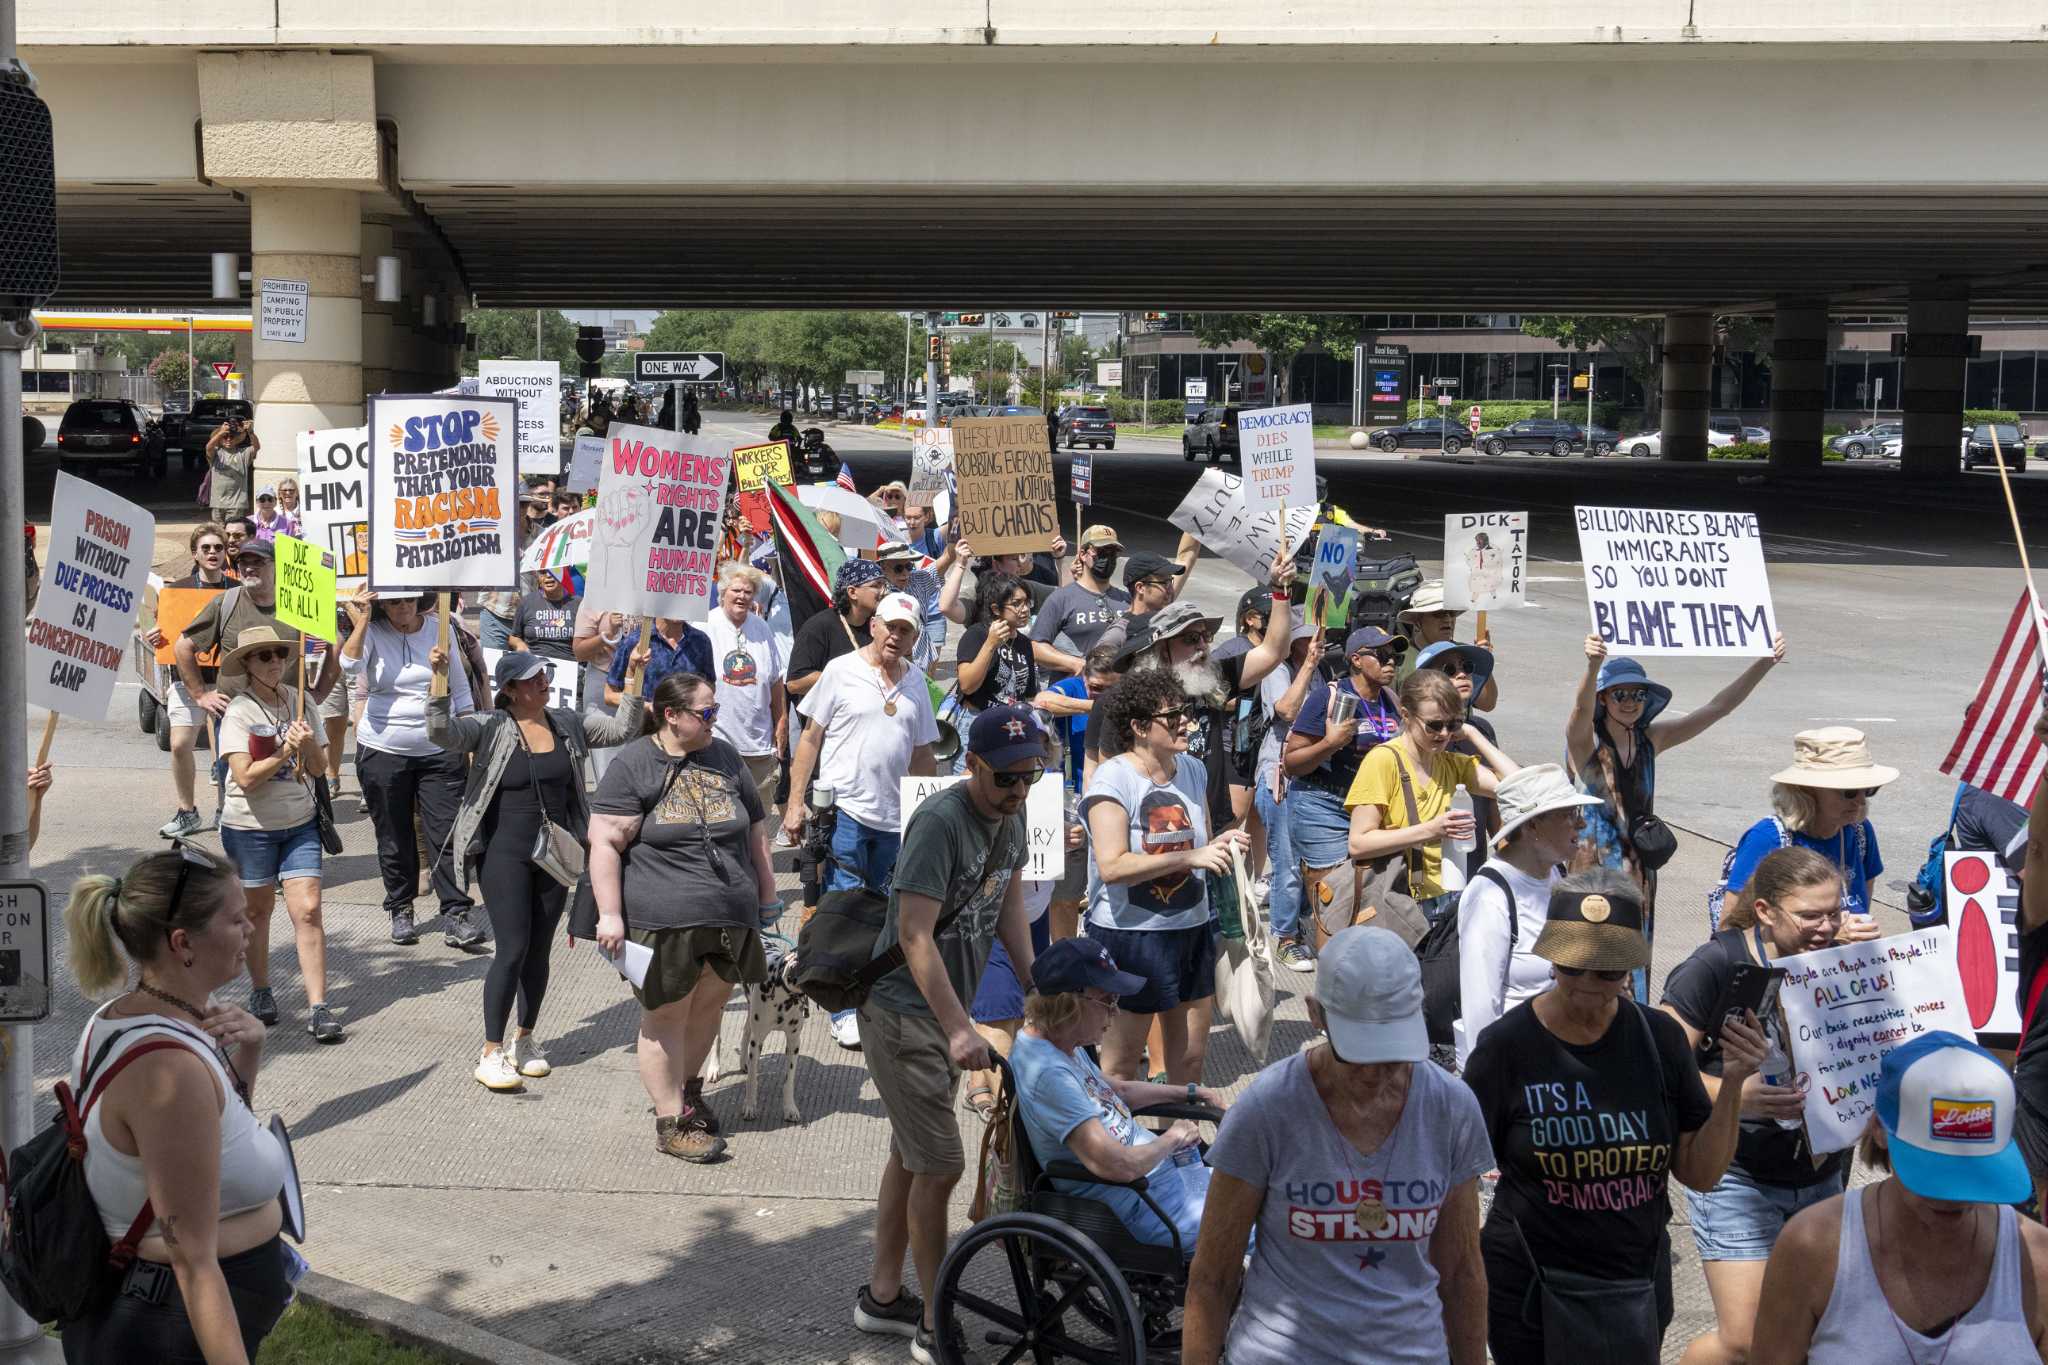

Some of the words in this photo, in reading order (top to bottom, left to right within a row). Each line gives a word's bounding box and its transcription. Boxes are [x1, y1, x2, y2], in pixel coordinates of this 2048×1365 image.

[263, 281, 306, 292] PROHIBITED
[262, 306, 271, 315] ON
[275, 307, 304, 317] PUBLIC
[266, 296, 300, 306] CAMPING
[264, 316, 302, 327] PROPERTY
[485, 376, 553, 386] ABDUCTIONS
[644, 362, 668, 374] ONE
[672, 362, 697, 374] WAY
[495, 388, 543, 398] WITHOUT
[404, 410, 480, 452] STOP
[518, 420, 545, 430] CESS
[1238, 411, 1312, 431] DEMOCRACY
[517, 432, 529, 441] RE
[517, 445, 554, 454] ERICAN
[953, 426, 991, 449] THESE
[991, 423, 1049, 445] VULTURES
[1256, 431, 1288, 448] DIES
[309, 442, 369, 473] LOC
[393, 443, 497, 475] PRETENDING
[612, 438, 725, 487] WOMENS
[736, 446, 782, 466] WORKERS
[956, 451, 1003, 478] ROBBING
[1004, 450, 1052, 474] EVERYONE
[1251, 448, 1293, 465] WHILE
[394, 472, 443, 498] THAT
[446, 465, 496, 491] YOUR
[1251, 466, 1295, 482] TRUMP
[305, 480, 363, 511] HIM
[656, 482, 720, 512] RIGHTS
[961, 480, 1013, 505] LEAVING
[1015, 475, 1056, 502] NOTHING
[1260, 483, 1291, 499] LIES
[394, 487, 502, 530] RACISM
[1192, 473, 1243, 537] DUTY
[84, 509, 131, 550] PRISON
[442, 524, 456, 540] IS
[651, 507, 718, 550] ARE
[962, 508, 988, 536] BUT
[991, 503, 1054, 538] CHAINS
[1577, 508, 1700, 536] BILLIONAIRES
[1704, 513, 1760, 538] BLAME
[74, 536, 130, 580] WITHOUT
[293, 542, 309, 566] DUE
[395, 533, 501, 568] PATRIOTISM
[648, 547, 712, 574] HUMAN
[1321, 541, 1345, 565] NO
[1510, 529, 1525, 593] TATOR
[1607, 539, 1730, 563] IMMIGRANTS
[54, 561, 81, 593] DUE
[78, 573, 133, 613] PROCESS
[283, 563, 314, 593] PROCESS
[646, 570, 708, 597] RIGHTS
[1591, 565, 1618, 589] SO
[1631, 565, 1669, 588] YOU
[1675, 567, 1728, 588] DONT
[279, 586, 293, 614] FOR
[72, 602, 85, 628] IS
[85, 608, 97, 632] A
[535, 609, 571, 621] CHINGA
[1593, 600, 1683, 648] BLAME
[1682, 602, 1774, 649] THEM
[28, 618, 123, 672] CONCENTRATION
[544, 626, 574, 638] MAGA
[50, 660, 87, 692] CAMP
[1784, 966, 1819, 989] People
[1821, 966, 1839, 978] are
[1839, 958, 1867, 977] People
[1870, 956, 1888, 966] are
[1814, 984, 1848, 1009] ALL
[1850, 977, 1871, 997] OF
[1800, 1025, 1824, 1042] Our
[1825, 1019, 1849, 1034] basic
[1914, 1001, 1945, 1015] voices
[1836, 1031, 1872, 1051] dignity
[1911, 1021, 1926, 1034] be
[1818, 1061, 1835, 1075] for
[1836, 1057, 1854, 1071] sale
[1857, 1054, 1868, 1063] or
[1869, 1052, 1879, 1061] a
[1524, 1082, 1569, 1115] IT'S
[1575, 1081, 1592, 1111] A
[1530, 1115, 1596, 1148] GOOD
[1598, 1109, 1650, 1143] DAY
[1836, 1109, 1856, 1123] but
[1534, 1151, 1568, 1179] TO
[1285, 1179, 1446, 1206] HOUSTON
